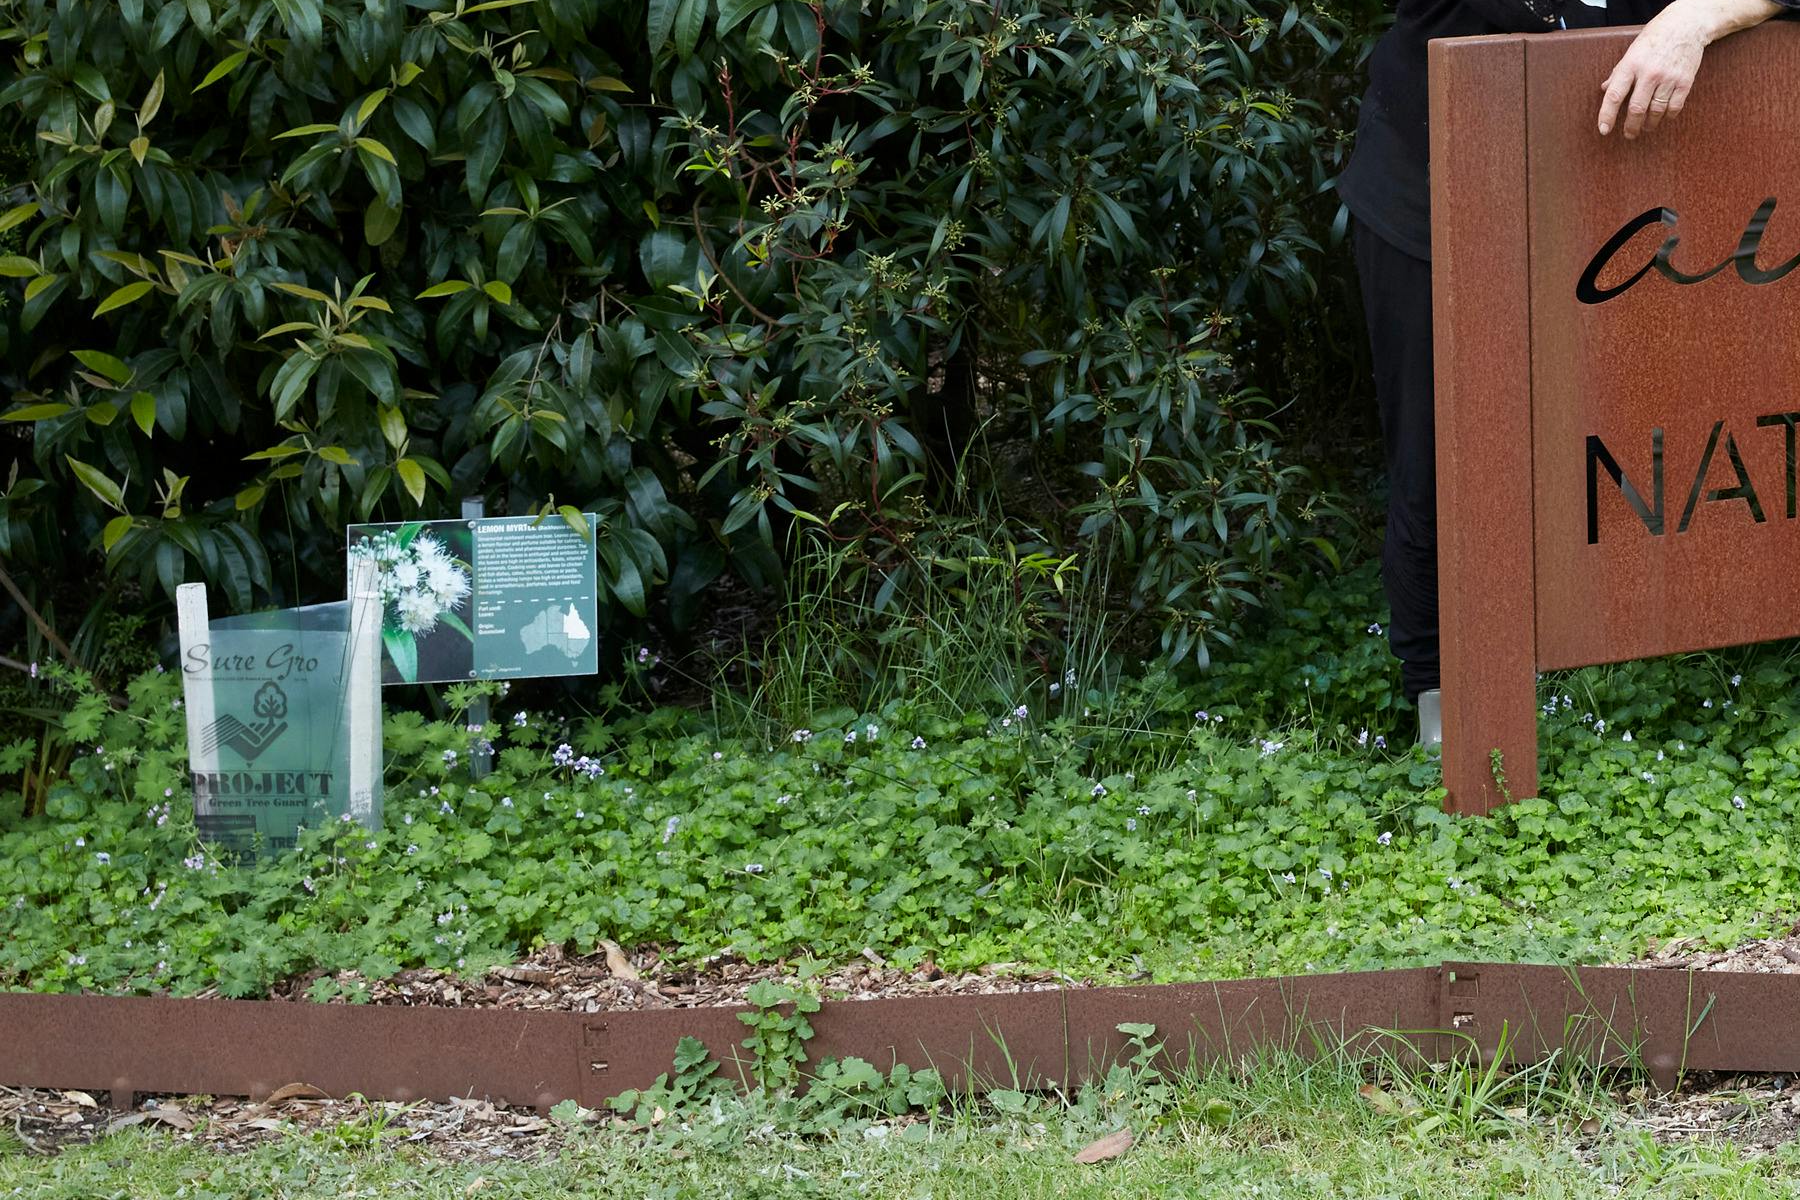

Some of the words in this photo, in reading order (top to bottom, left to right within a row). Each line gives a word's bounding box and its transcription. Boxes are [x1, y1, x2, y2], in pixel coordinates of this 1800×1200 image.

[477, 525, 505, 533] LEMON
[183, 643, 256, 674] Sure
[265, 643, 319, 681] Gro
[190, 772, 334, 795] PROJECT
[209, 798, 242, 808] Green
[246, 798, 271, 808] Tree
